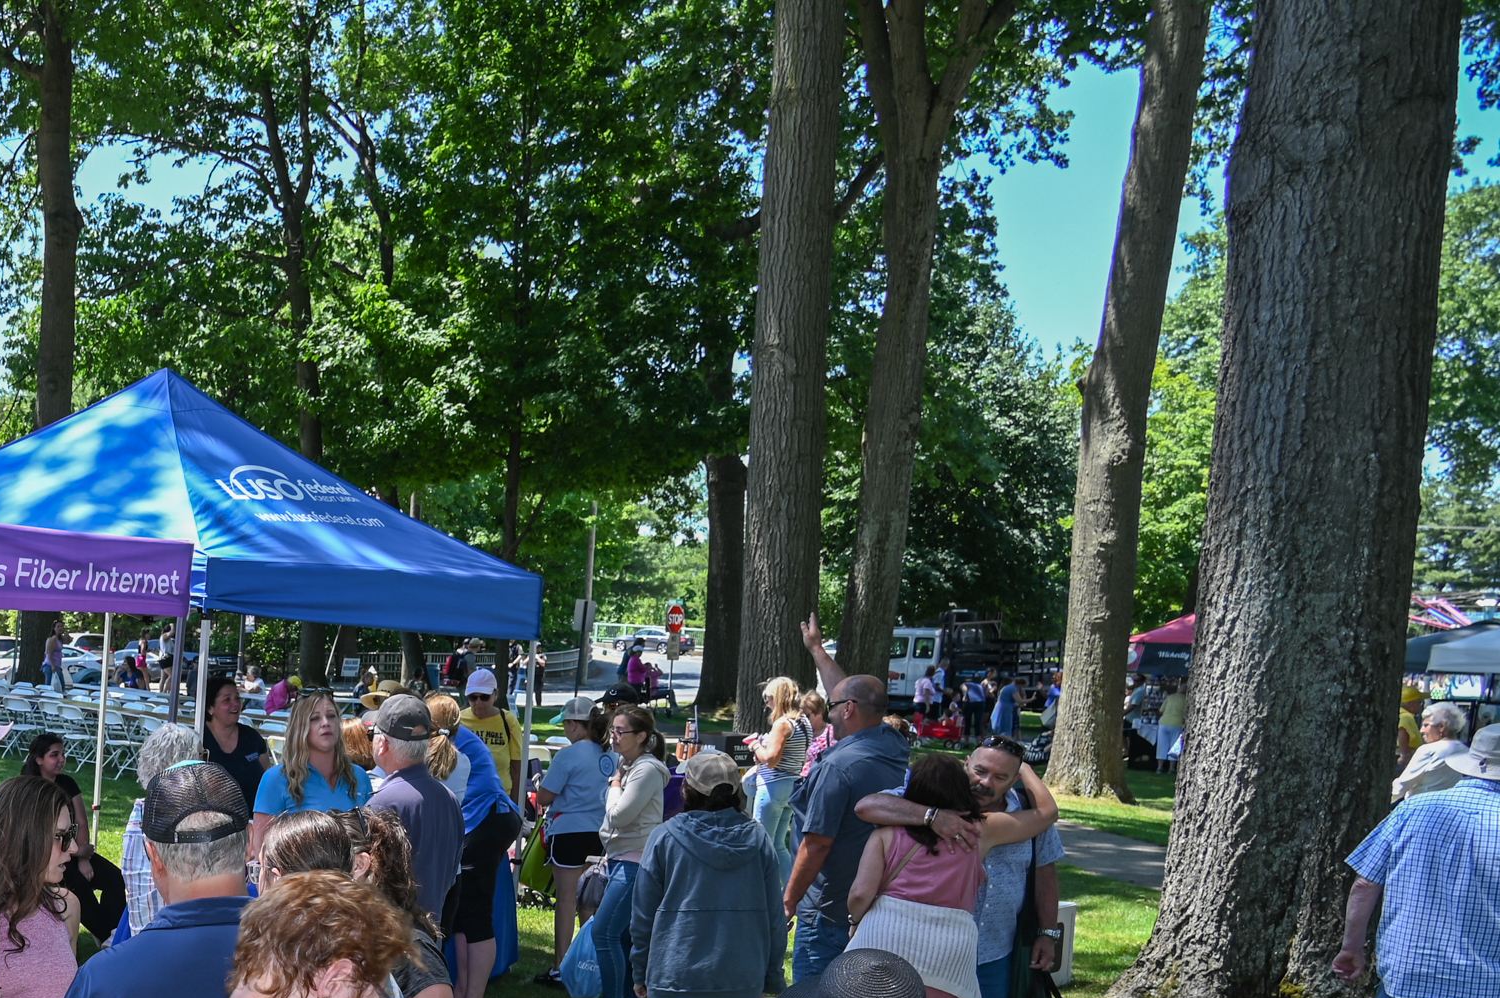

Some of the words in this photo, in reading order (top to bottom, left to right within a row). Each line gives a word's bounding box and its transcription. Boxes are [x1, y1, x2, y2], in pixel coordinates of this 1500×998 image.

[214, 477, 305, 501] LUSO
[297, 478, 352, 498] federal
[254, 510, 385, 528] www.lusofederal.com
[14, 557, 81, 592] Fiber
[84, 562, 180, 596] Internet
[668, 613, 683, 625] STOP
